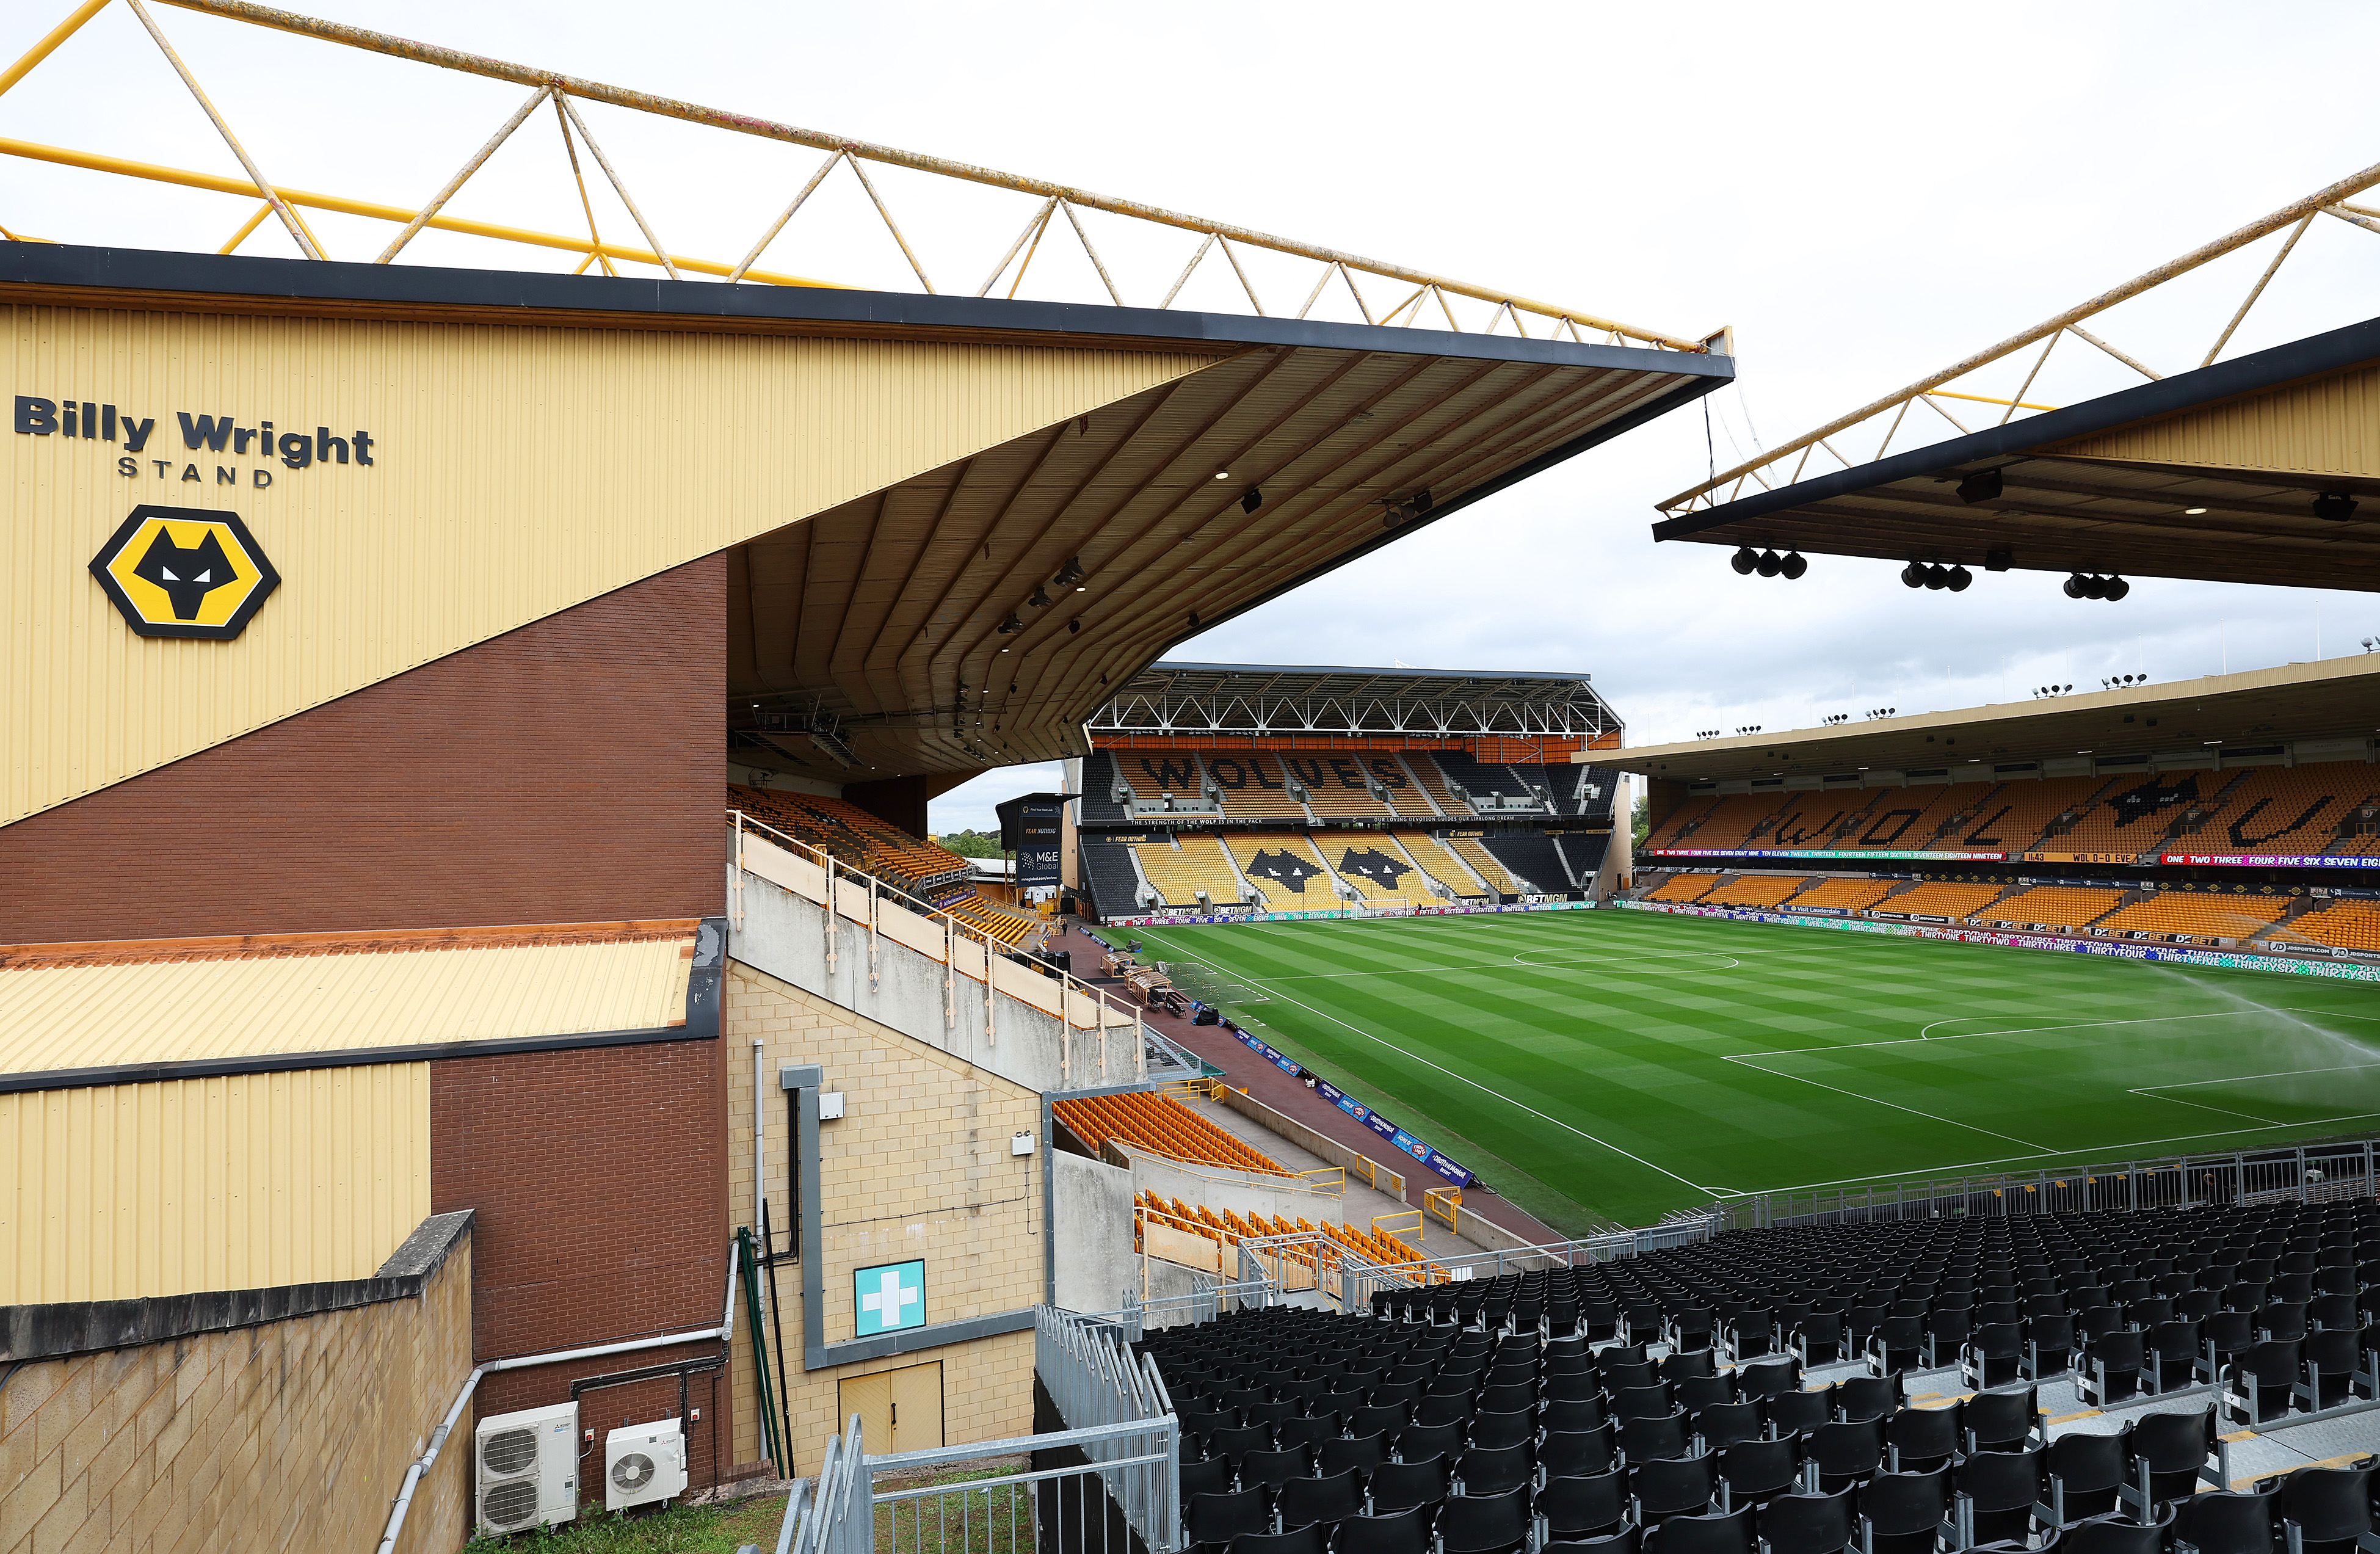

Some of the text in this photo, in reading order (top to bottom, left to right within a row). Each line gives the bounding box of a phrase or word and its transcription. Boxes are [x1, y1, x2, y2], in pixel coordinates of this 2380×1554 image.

[14, 395, 374, 468] Billy Wright
[118, 456, 272, 488] STAND
[1141, 758, 1408, 790] WOLVES
[1036, 851, 1059, 862] M&E
[2028, 853, 2044, 862] 11:43
[2073, 854, 2089, 862] WOL
[2116, 854, 2131, 863] EVE
[2167, 855, 2380, 867] ONE TWO THREE FOUR FIVE SIX SEVEN EIG
[1526, 893, 1568, 904] BETMGM
[1672, 907, 1699, 916] TWENTYFOUR
[1702, 910, 1729, 919] TWENTYFIVE
[1733, 913, 1759, 921] TWENTYSIX
[1763, 916, 1800, 926] TWENTYSEVEN
[1920, 930, 1959, 941] THIRTYONE
[1964, 933, 2009, 946] THIRTYTWO
[2017, 939, 2076, 952] THIRTYTHREE
[2085, 945, 2146, 959] THIRTYFOUR
[2157, 951, 2221, 967] THIRTYFIVE
[2233, 958, 2299, 974] THIRTYSIX
[2287, 945, 2330, 954] JDSPORTS.COM
[1397, 1135, 1407, 1144] HOME
[1439, 1167, 1451, 1177] Resort
